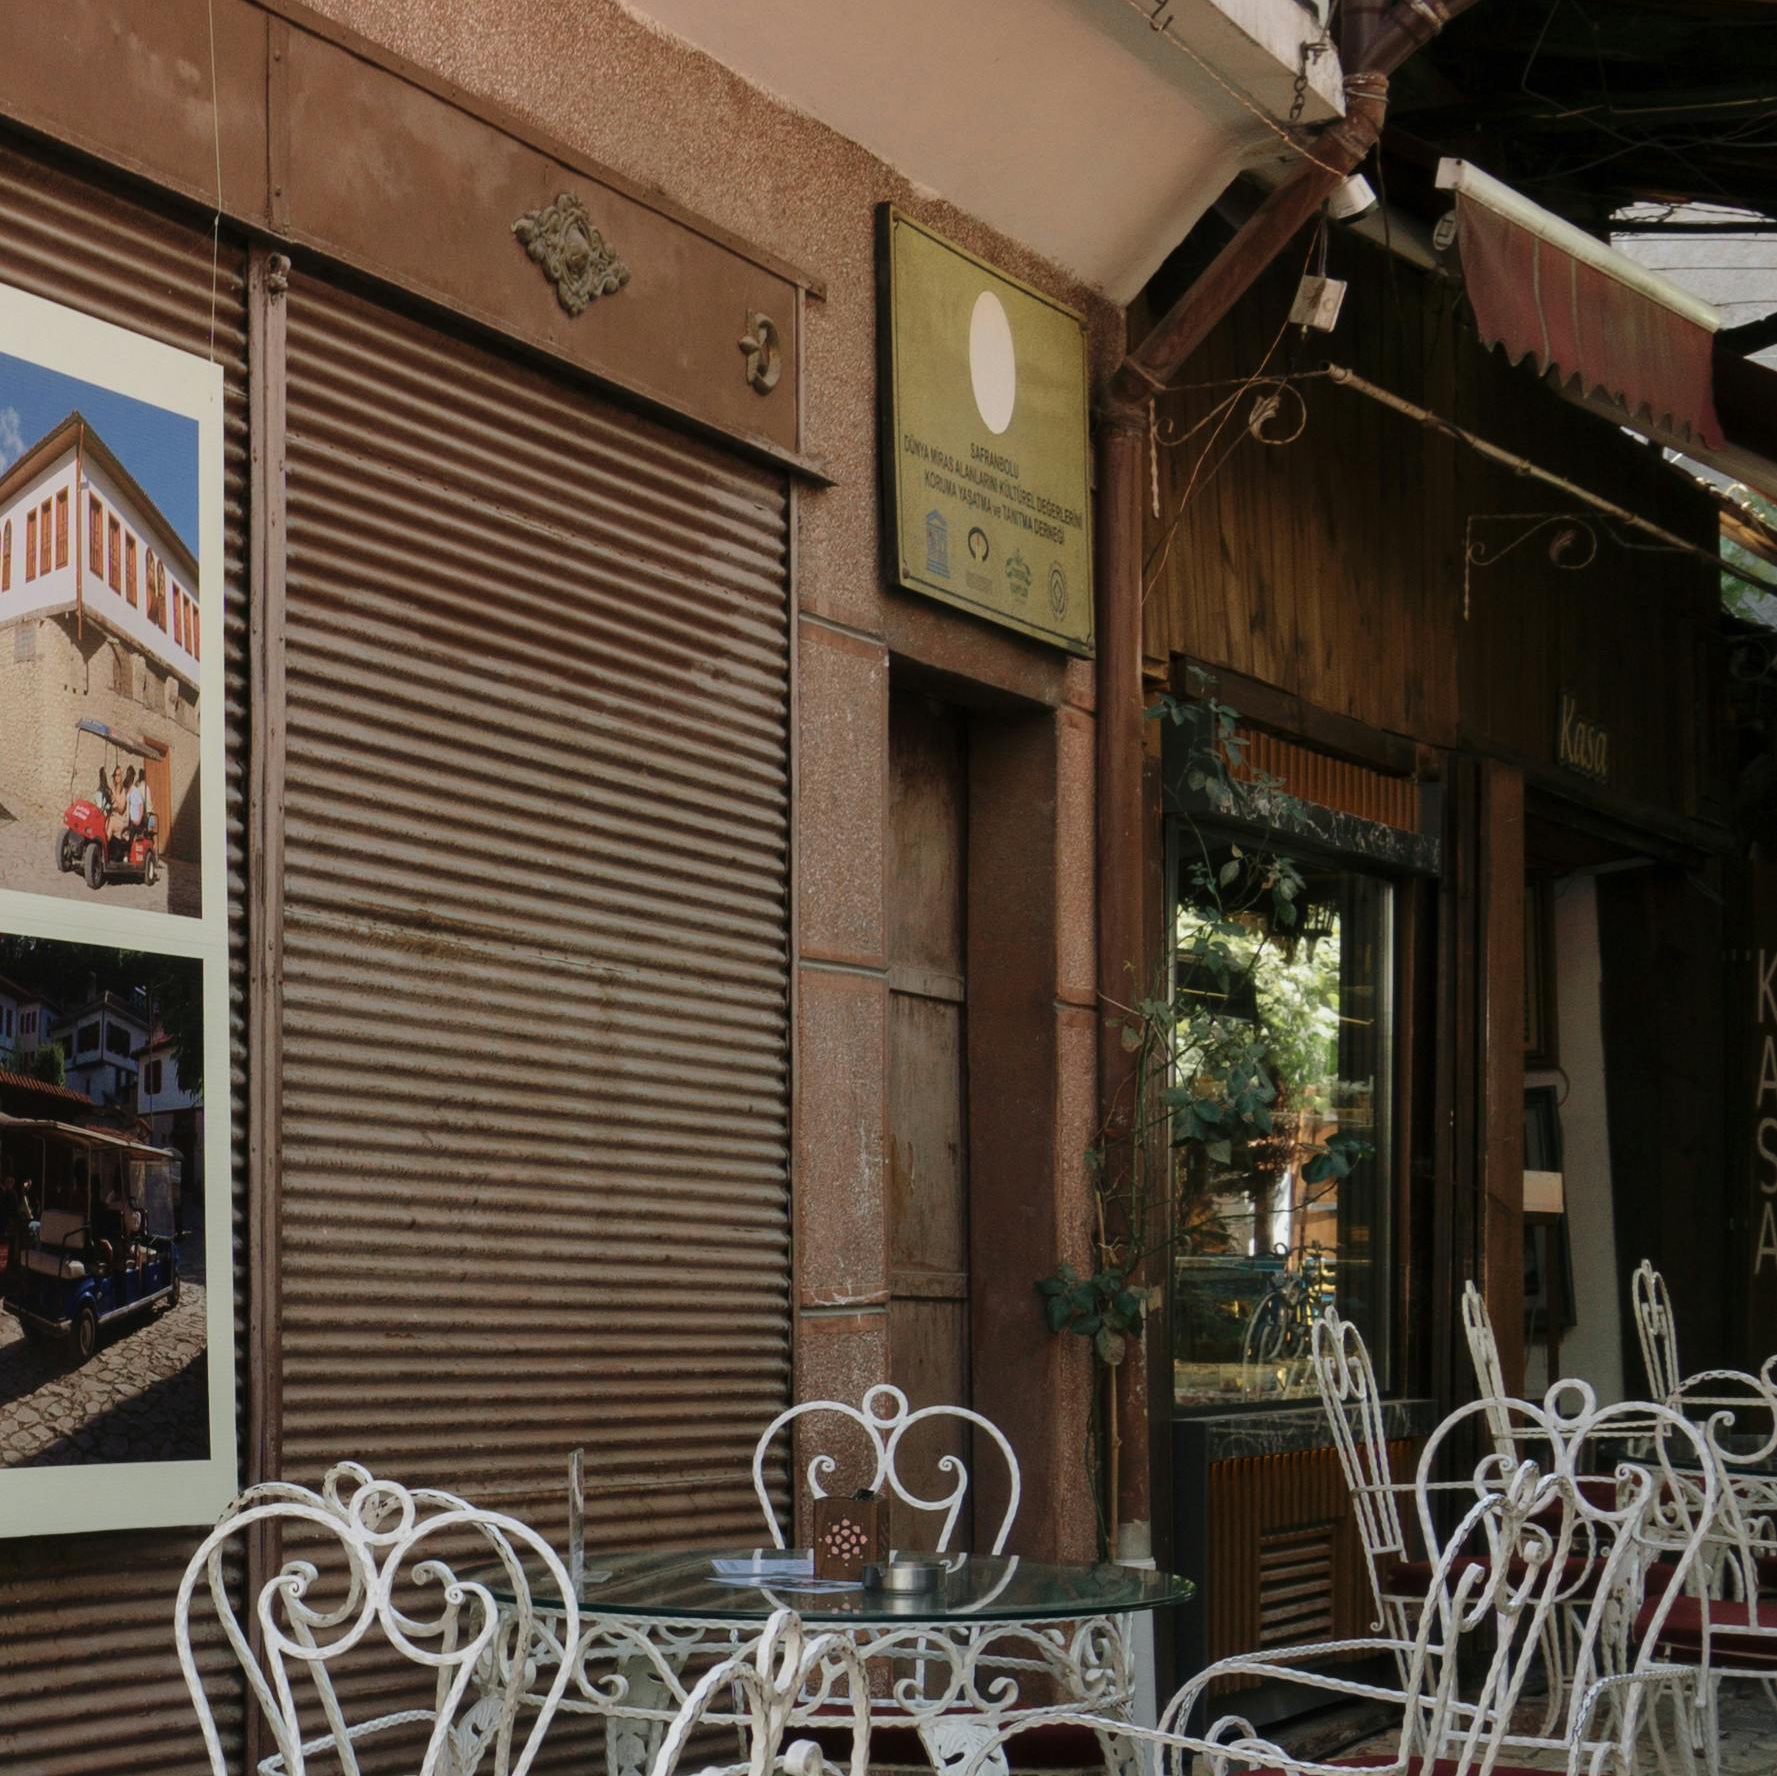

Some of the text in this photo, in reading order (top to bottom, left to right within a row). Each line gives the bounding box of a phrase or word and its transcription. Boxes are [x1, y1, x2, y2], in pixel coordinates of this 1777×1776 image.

[904, 434, 929, 463] DÜNYA
[970, 442, 1020, 480] SAFRANBOLU
[925, 471, 957, 498] KORUMA
[1560, 694, 1608, 778] Kasa
